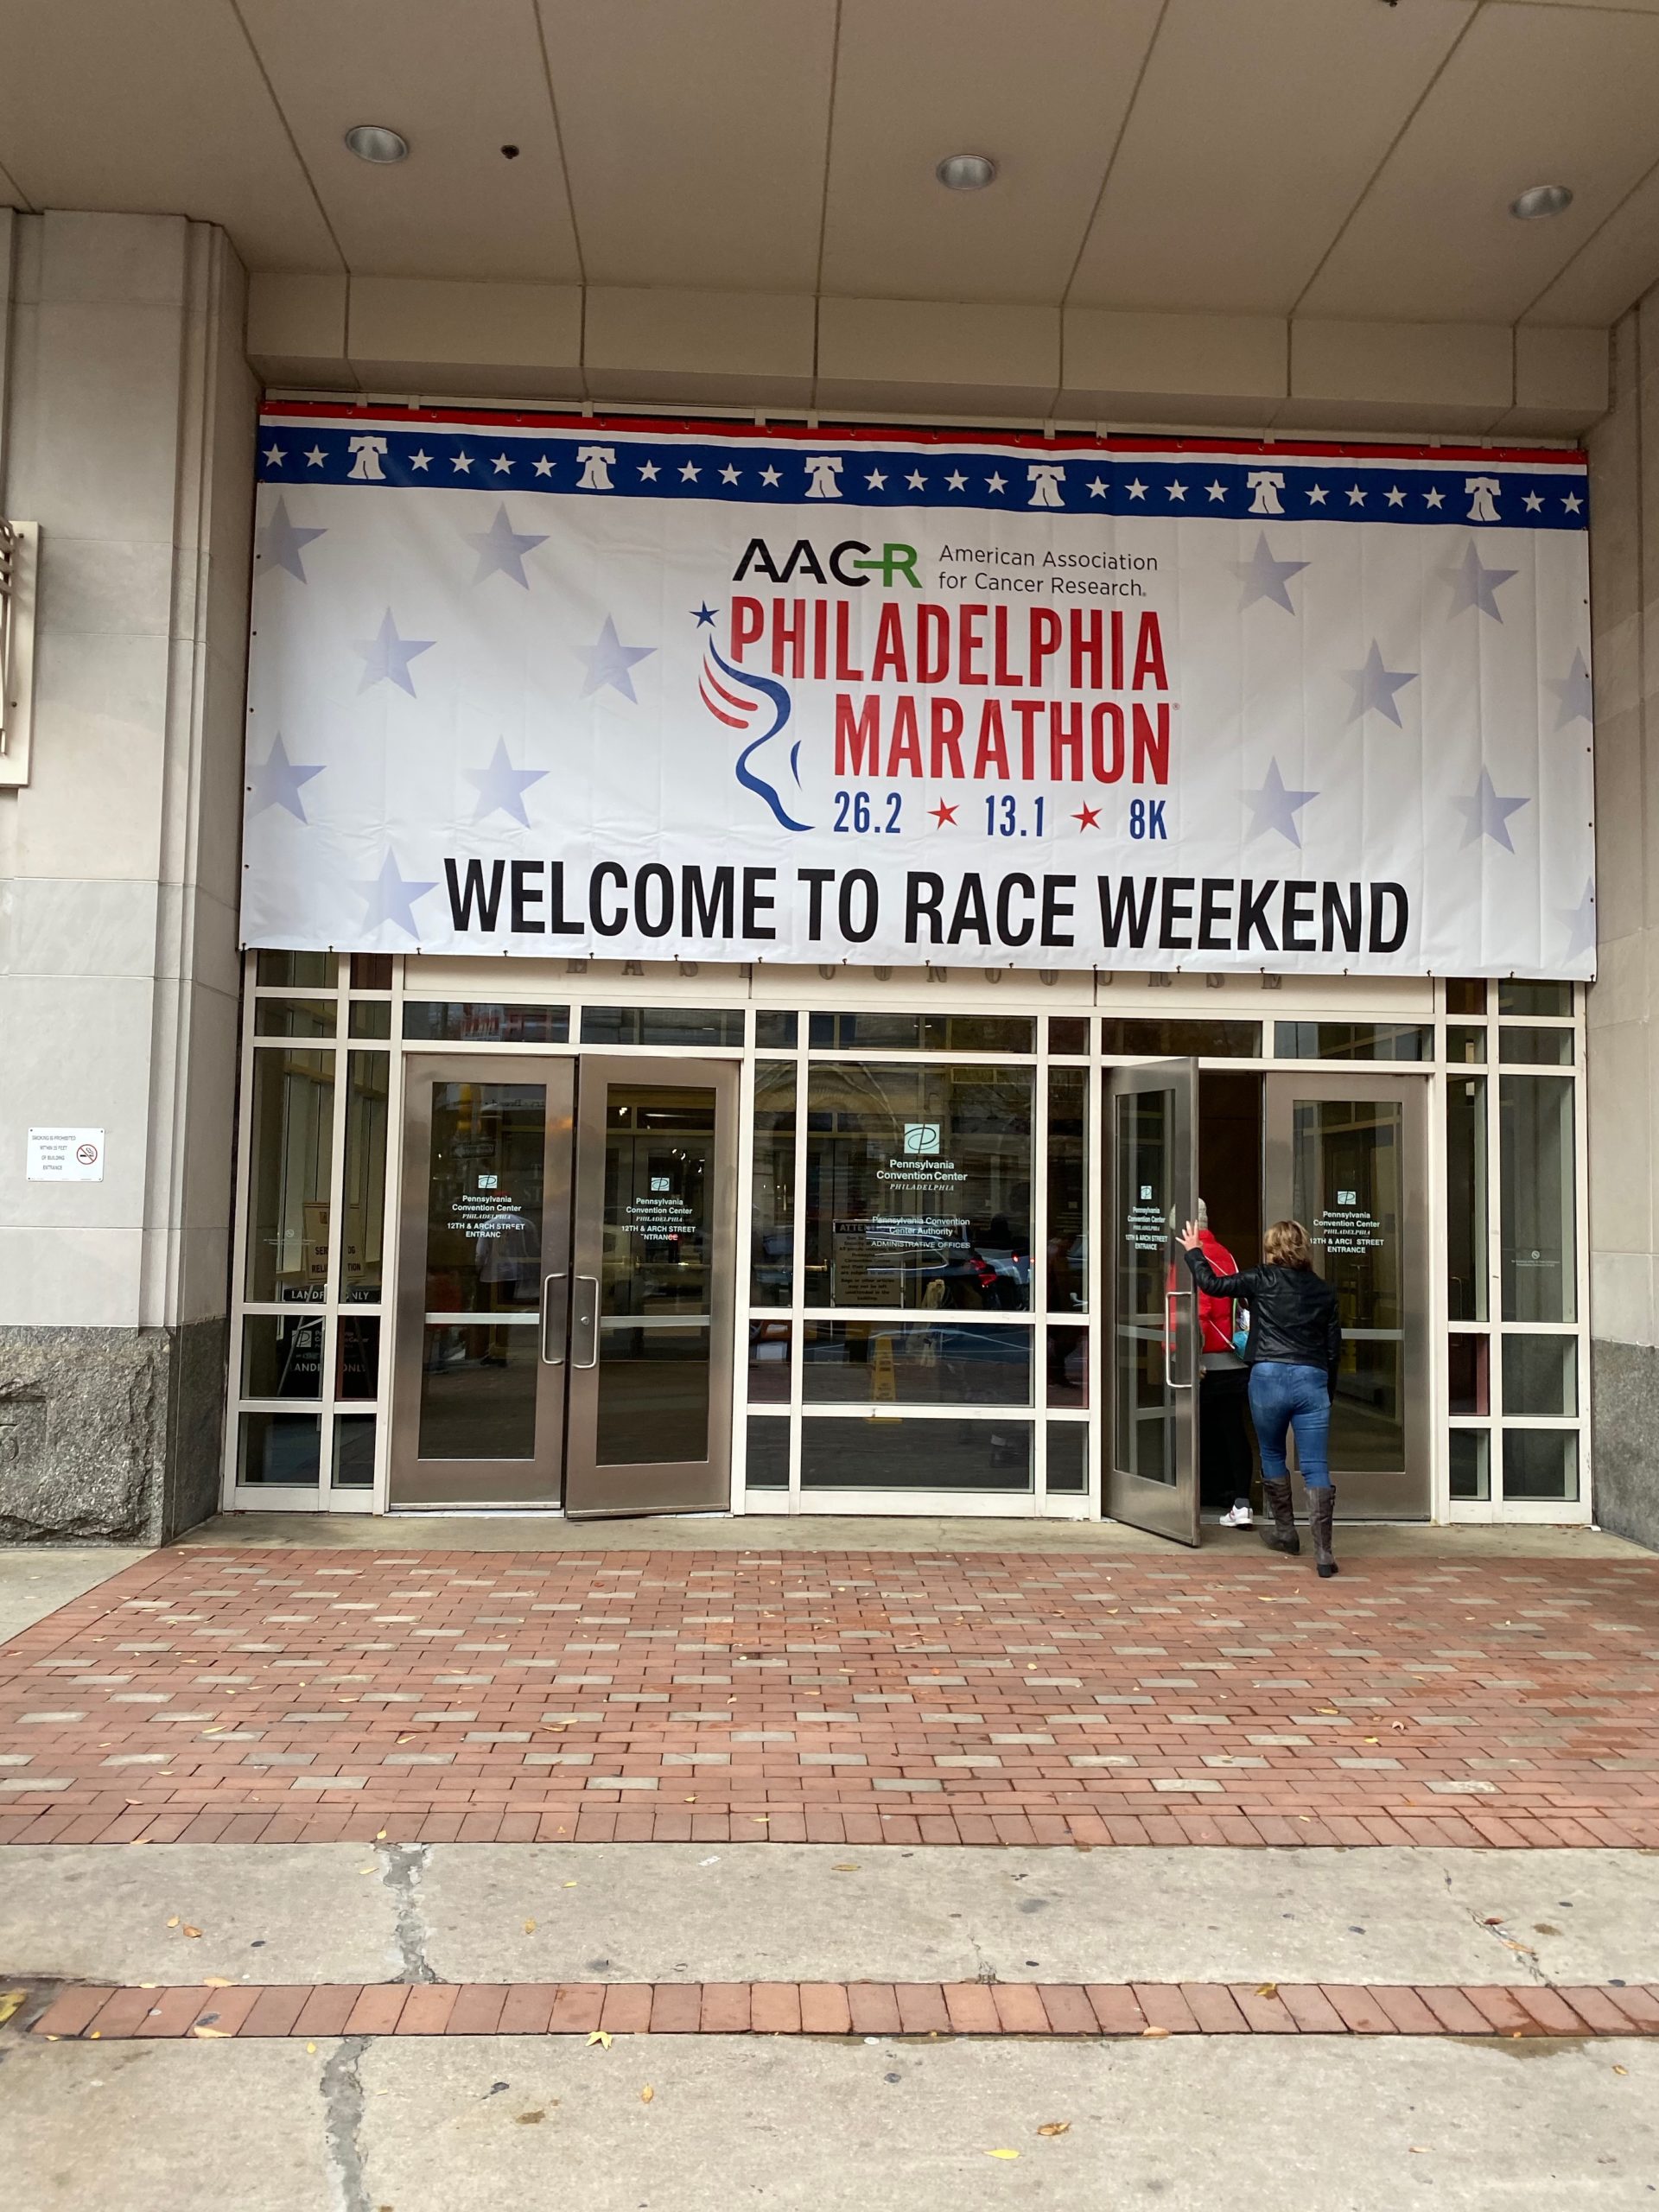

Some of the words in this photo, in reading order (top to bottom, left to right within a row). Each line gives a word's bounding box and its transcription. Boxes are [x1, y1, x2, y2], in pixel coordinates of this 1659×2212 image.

[732, 538, 923, 588] AACR
[939, 544, 1035, 567] American
[1043, 551, 1158, 571] Association
[940, 571, 968, 589] for
[975, 573, 1044, 593] Cancer
[731, 596, 1169, 690] PHILADELPHIA
[833, 791, 902, 834] 26.2
[985, 795, 1045, 837] 13.1
[1129, 799, 1167, 840] 8K
[444, 858, 777, 940] WELCOME
[798, 868, 880, 944] TO
[905, 871, 1077, 948] RACE
[1097, 874, 1409, 954] WEEKEND
[889, 1159, 955, 1170] Pennsylvania
[876, 1170, 932, 1179] Convention
[934, 1172, 968, 1181] Center
[462, 1195, 512, 1204] Pennsylvania
[636, 1198, 683, 1206] Pennsylvania
[872, 1216, 924, 1225] Pennsylvania
[925, 1217, 970, 1225] Convention
[1323, 1211, 1370, 1219] Pennsylvania
[917, 1227, 953, 1236] Authority
